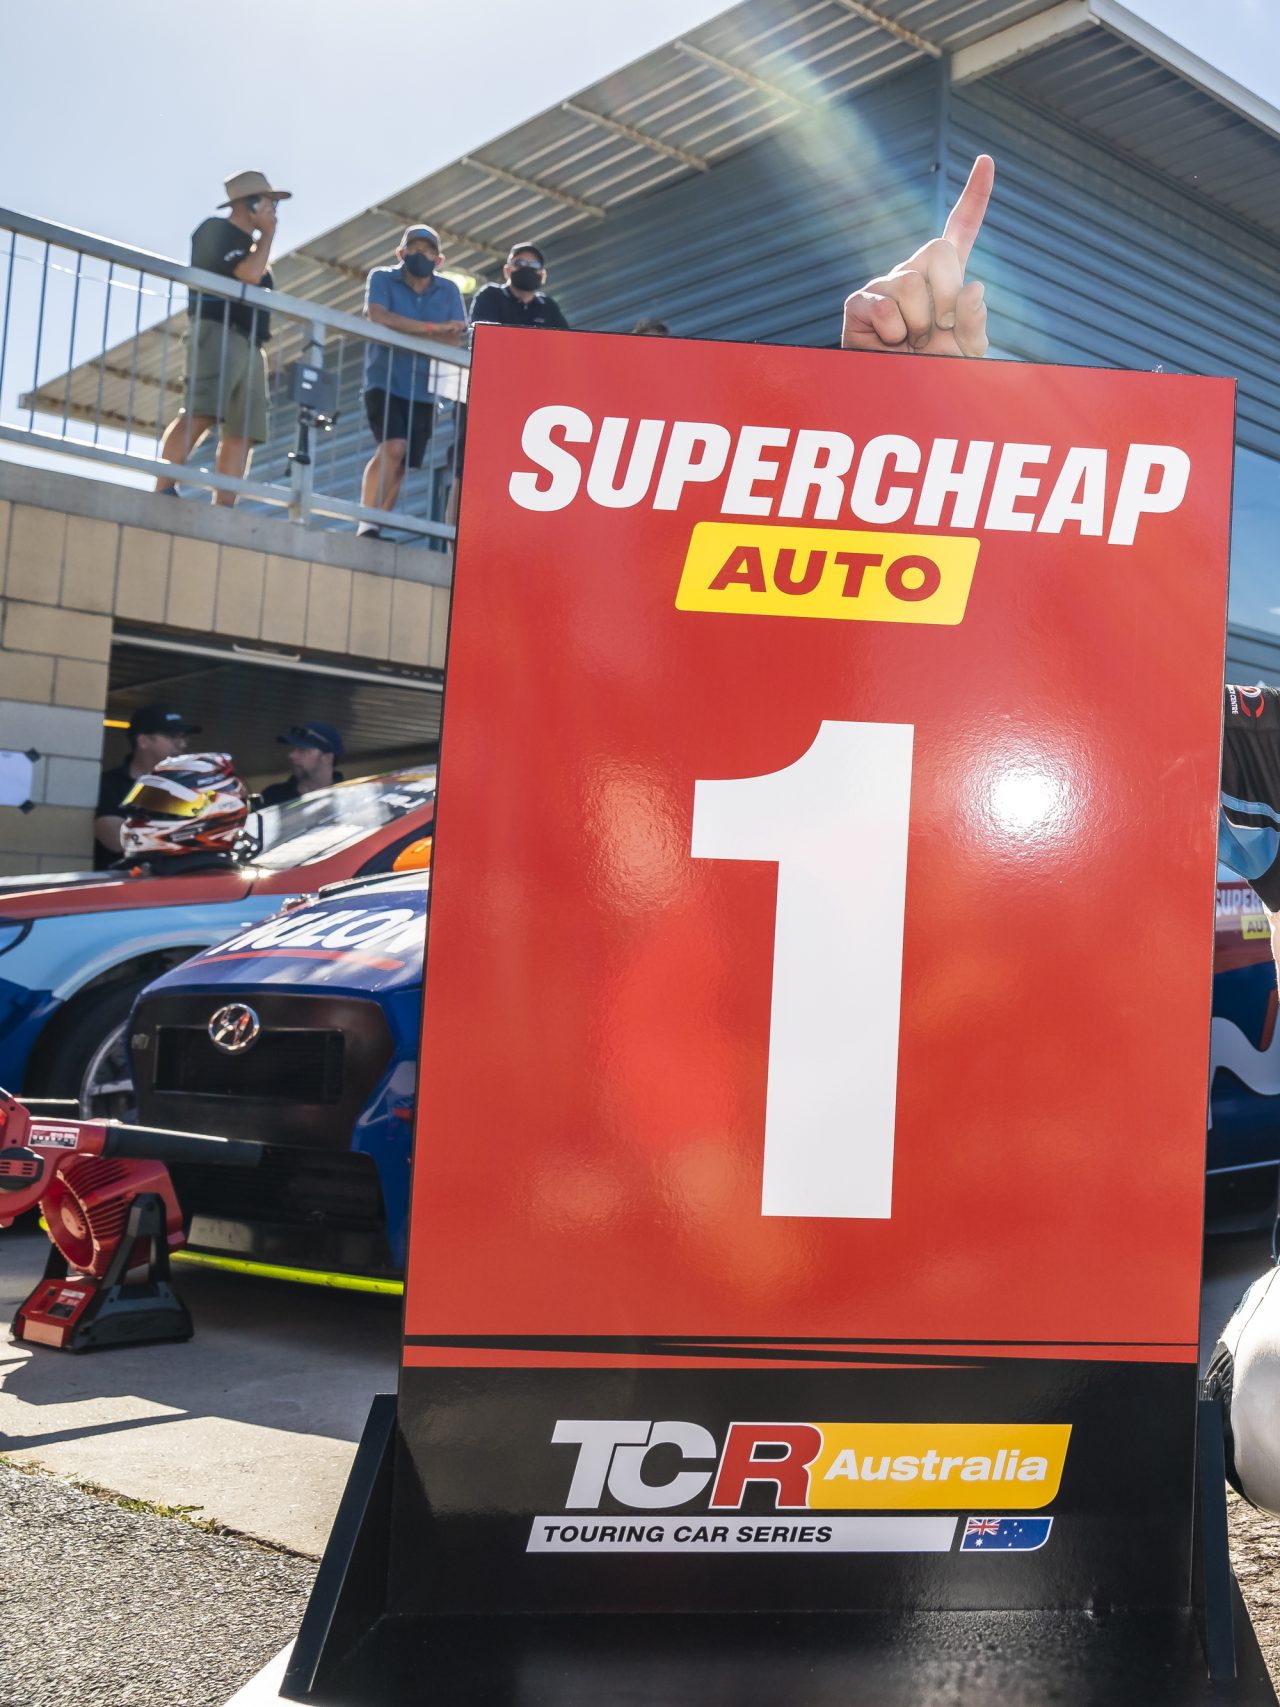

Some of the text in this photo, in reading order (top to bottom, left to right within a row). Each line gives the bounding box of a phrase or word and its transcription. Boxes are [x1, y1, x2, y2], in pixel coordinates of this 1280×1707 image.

[508, 404, 1192, 546] SUPERCHEAP
[708, 545, 942, 603] AUTO
[691, 719, 915, 1219] 1
[550, 1419, 1049, 1509] TCR Australia
[543, 1525, 833, 1543] TOURING CAR SERIES
